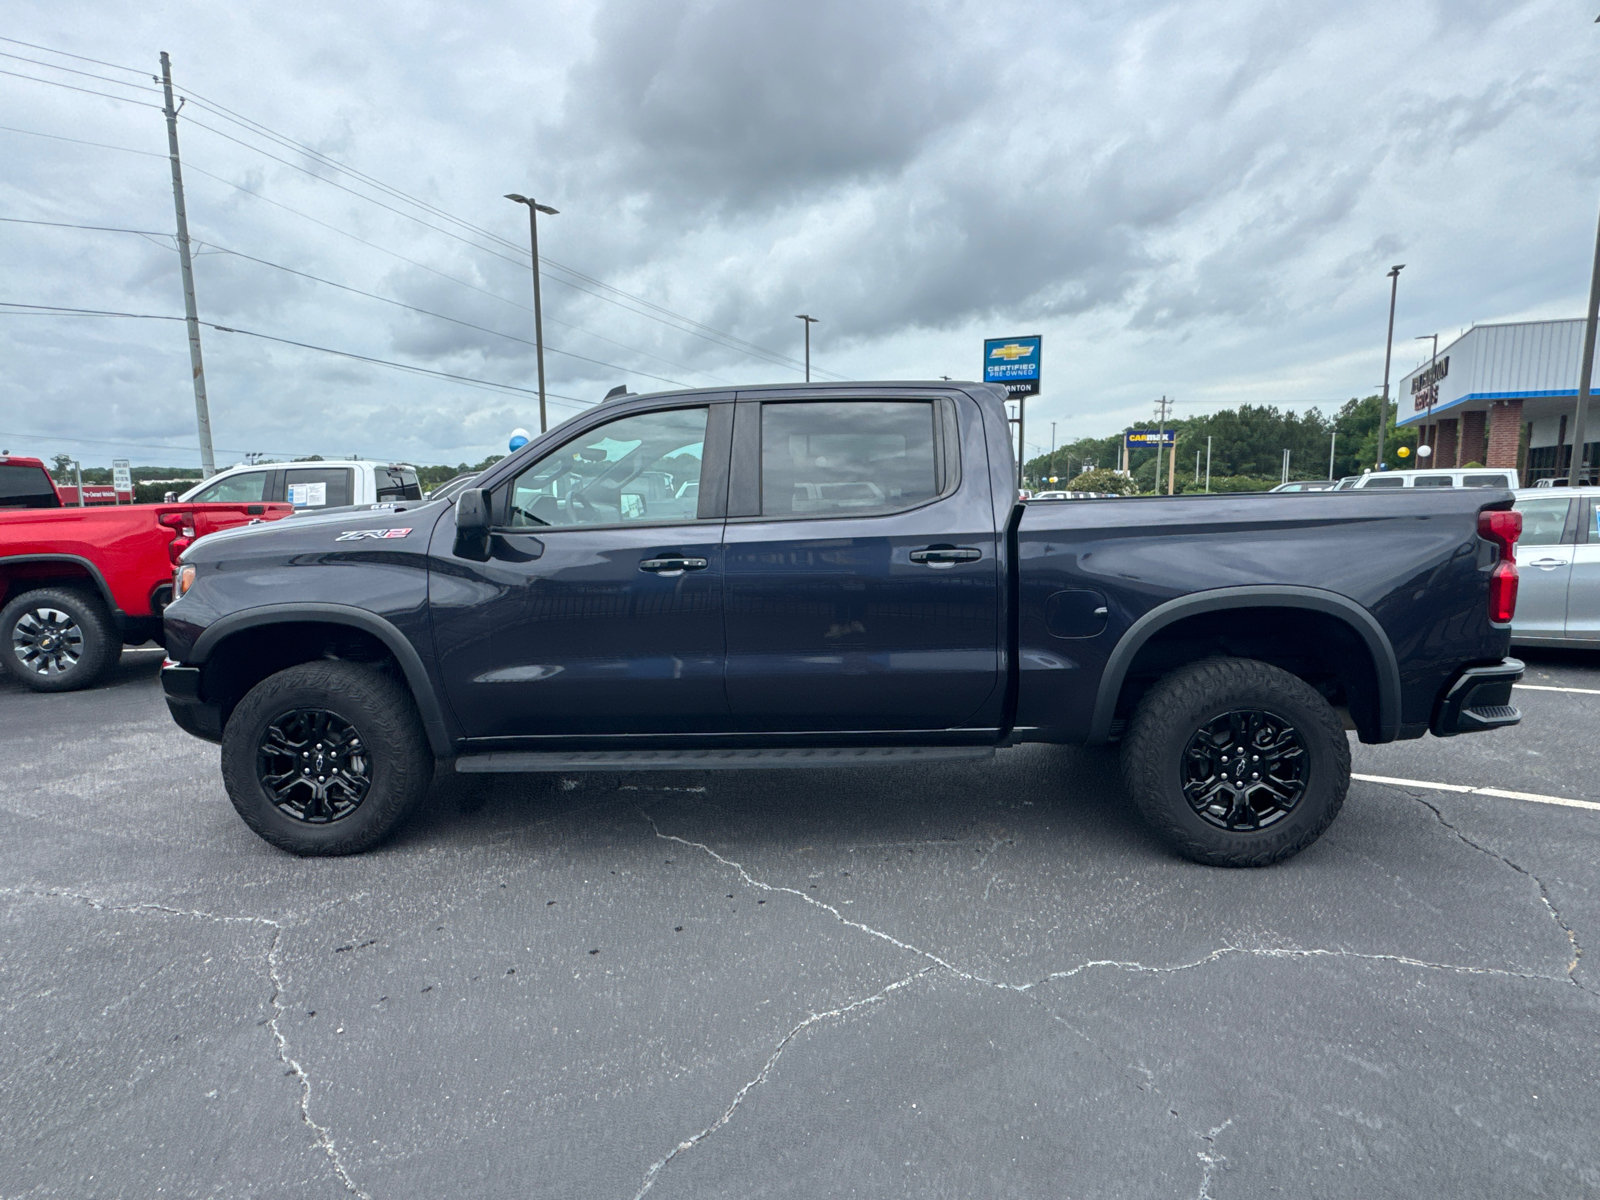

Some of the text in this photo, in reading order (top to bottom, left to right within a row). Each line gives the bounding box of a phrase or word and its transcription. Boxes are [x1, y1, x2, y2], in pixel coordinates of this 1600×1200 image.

[987, 363, 1036, 373] CERTIFIED
[989, 369, 1034, 378] PRE-OWNED
[335, 527, 413, 542] ZR2
